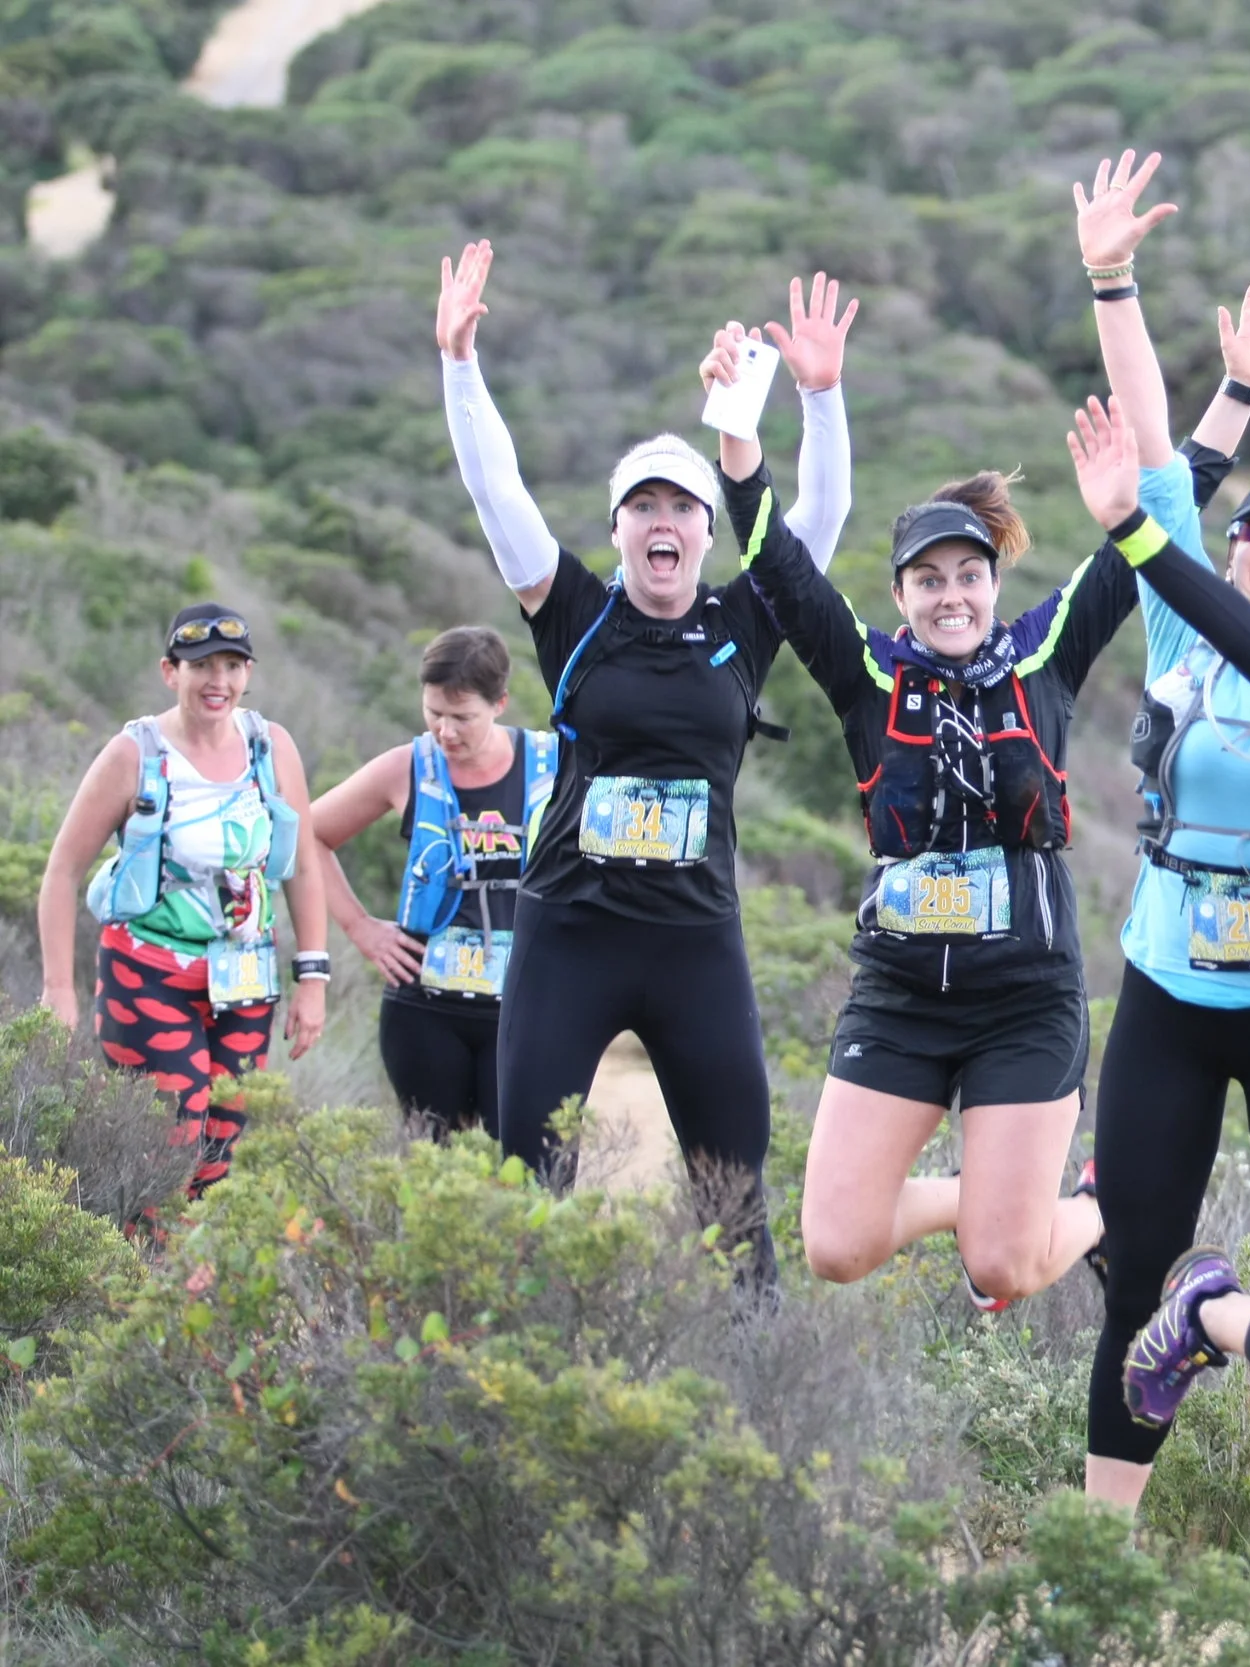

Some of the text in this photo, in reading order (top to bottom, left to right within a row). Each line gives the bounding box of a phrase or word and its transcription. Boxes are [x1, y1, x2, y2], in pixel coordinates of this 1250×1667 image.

[626, 802, 662, 841] 34
[920, 876, 971, 915] 285
[918, 918, 973, 932] Surf Coast
[456, 946, 484, 977] 94
